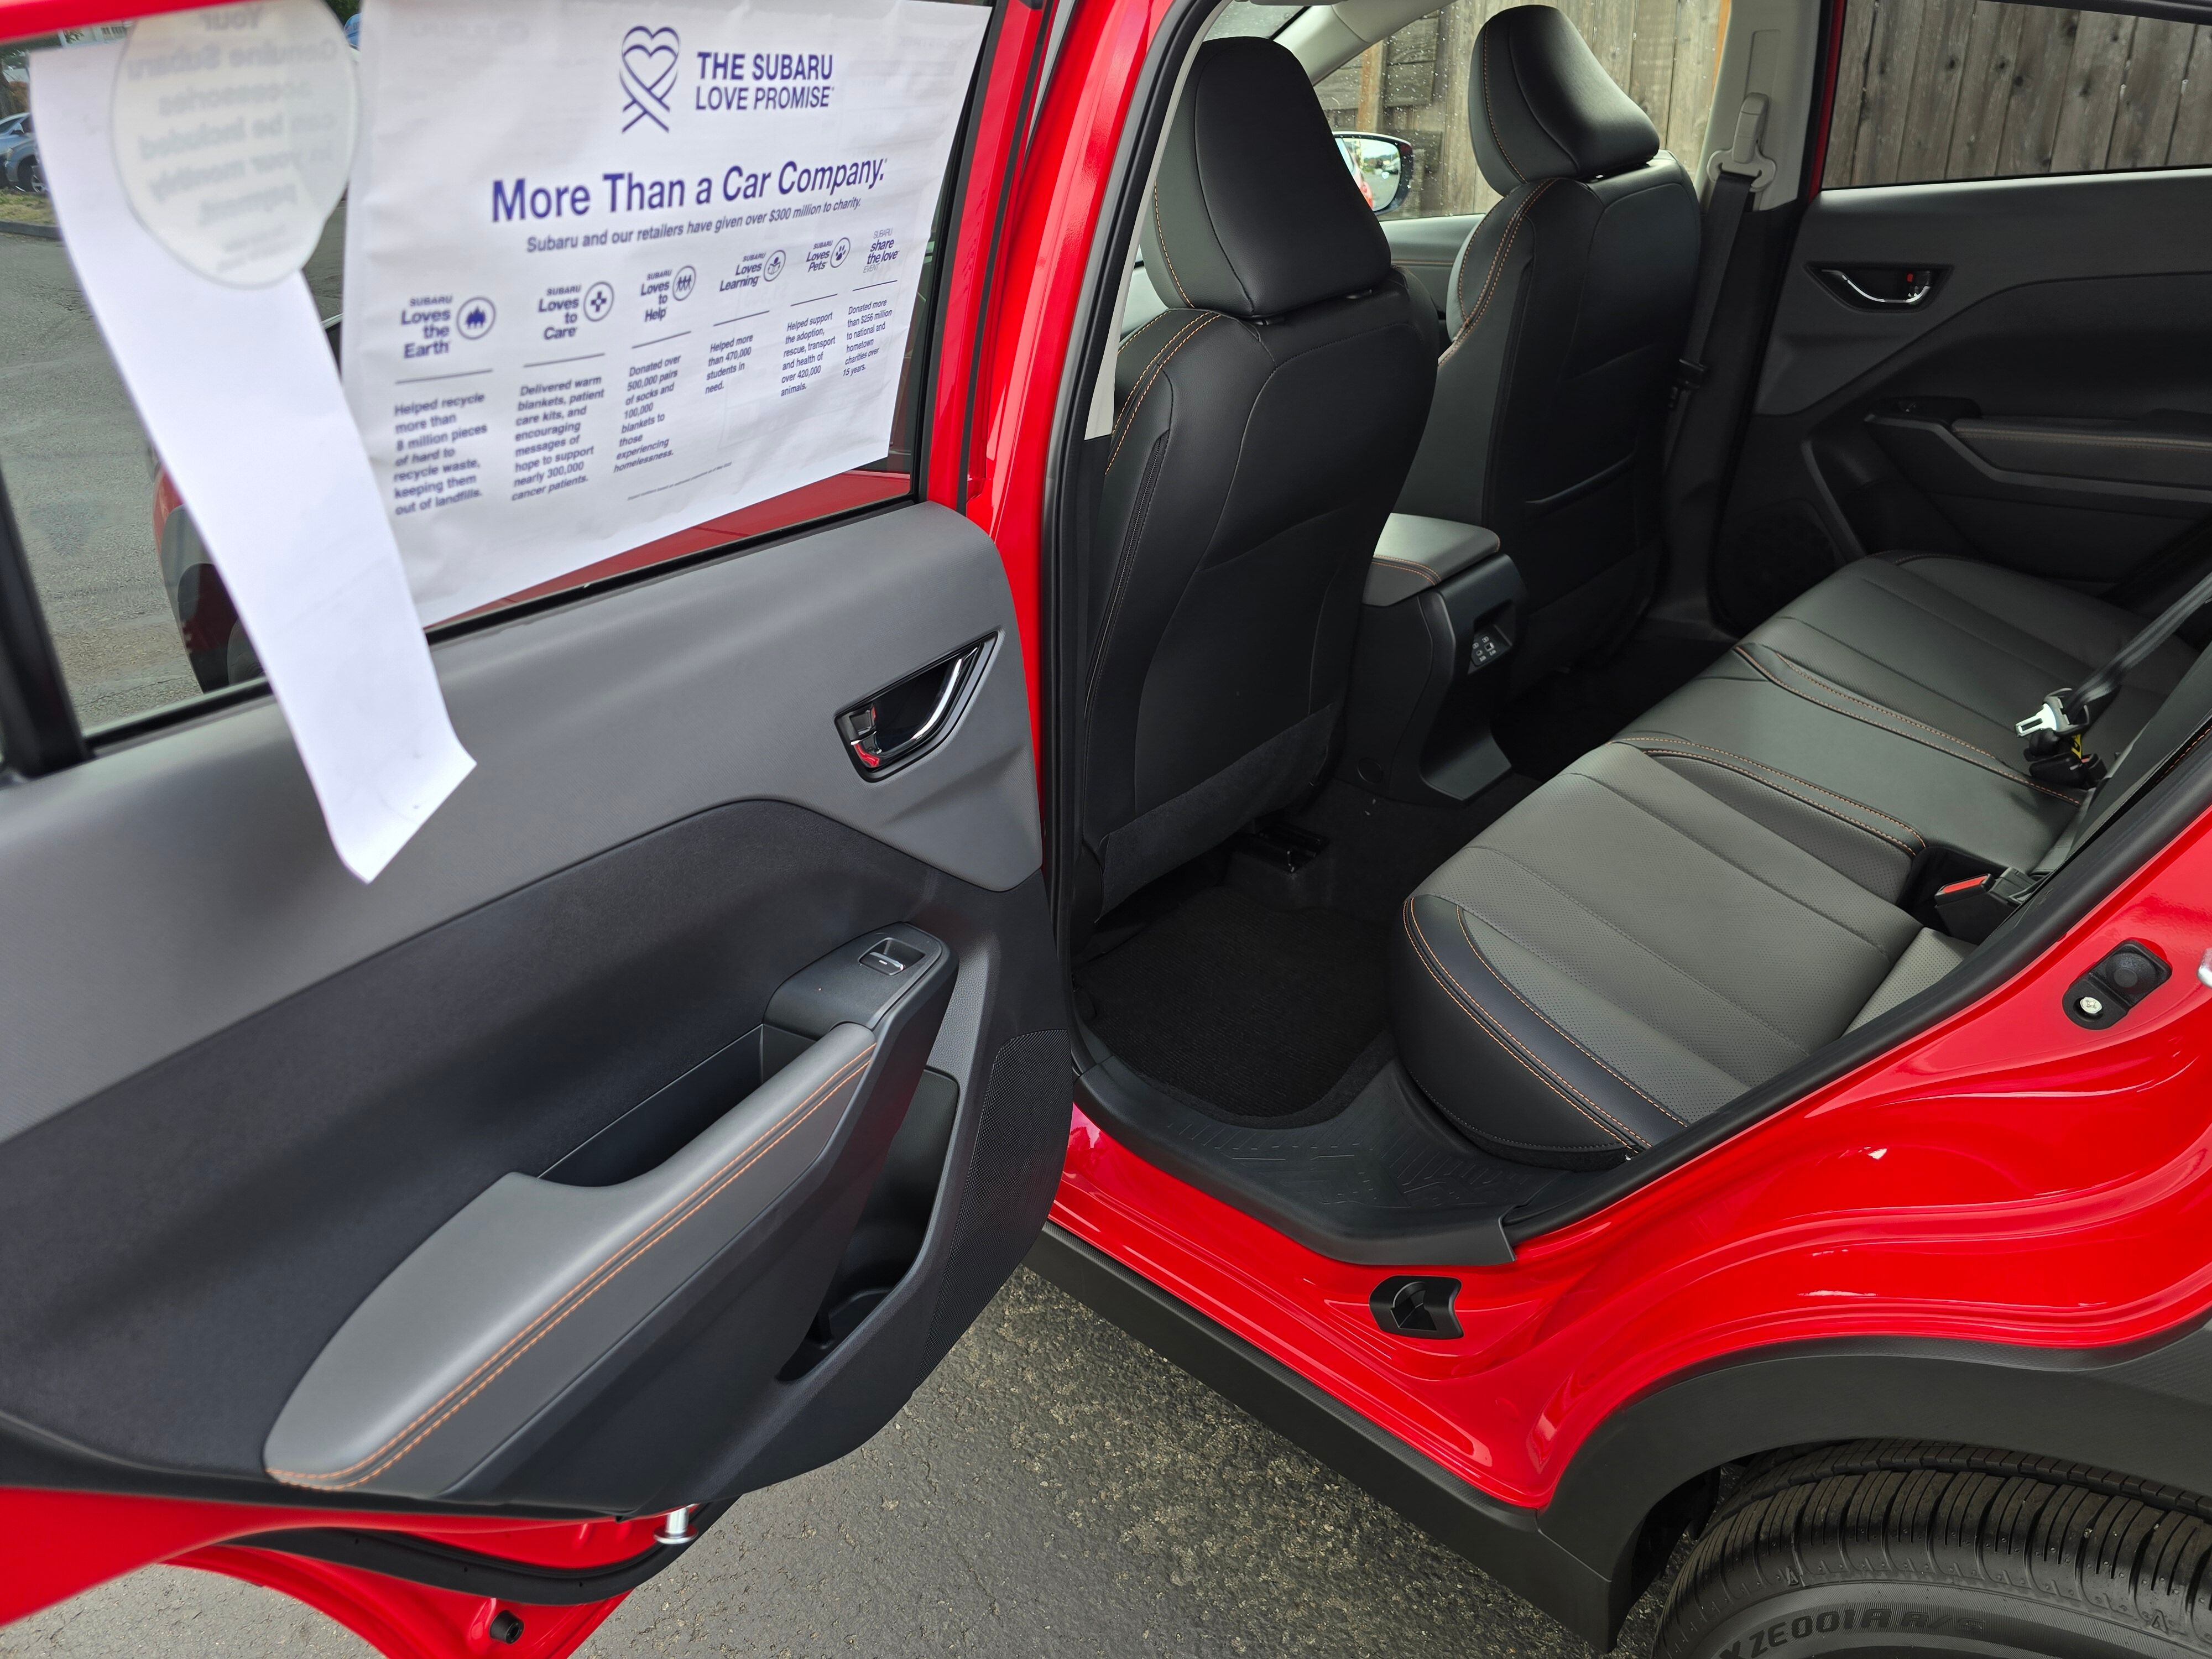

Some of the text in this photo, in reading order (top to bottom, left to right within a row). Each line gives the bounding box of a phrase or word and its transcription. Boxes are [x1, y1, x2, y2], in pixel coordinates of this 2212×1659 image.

[696, 52, 833, 80] THE SUBARU
[696, 85, 830, 111] LOVE PROMISE
[492, 157, 884, 223] More Than a Car Company.
[526, 196, 861, 253] Subaru and our retailers have given over $300 million to charity.
[873, 227, 893, 239] SUBARU
[813, 240, 833, 250] SUBARU
[870, 239, 894, 252] share
[742, 253, 766, 262] SUBARU
[805, 251, 830, 262] Loves
[647, 270, 672, 281] SUBARU
[735, 263, 762, 275] Loves
[807, 262, 826, 272] Pets
[863, 263, 880, 273] EVENT
[546, 285, 582, 296] SUBARU
[640, 281, 670, 296] Loves
[719, 275, 759, 292] Learning
[409, 295, 453, 307] SUBARU
[538, 298, 580, 312] Loves
[659, 294, 668, 305] to
[848, 299, 887, 315] Donated more
[401, 309, 451, 325] Loves
[565, 312, 578, 324] to
[645, 307, 666, 322] Help
[786, 311, 833, 332] Helped support
[847, 309, 892, 328] than $256 million
[423, 325, 450, 338] the
[544, 326, 576, 340] Care
[785, 327, 825, 345] the adoption,
[853, 325, 874, 338] national
[876, 321, 885, 331] and
[404, 341, 449, 358] Earth
[710, 335, 753, 353] Helped more
[783, 336, 836, 358] rescue, transport
[846, 338, 874, 353] hometown
[708, 347, 752, 367] than 470,000
[782, 351, 823, 371] and health of
[845, 347, 879, 366] charities over
[629, 355, 681, 377] Donated over
[707, 362, 745, 380] students in
[781, 365, 821, 384] over 420,000
[843, 365, 866, 377] 15 years.
[520, 376, 602, 397] Delivered warm
[627, 369, 678, 392] 500,000 pairs
[706, 380, 724, 394] need.
[781, 382, 806, 397] animals.
[518, 389, 605, 411] blankets, patient
[625, 383, 675, 406] of socks and
[394, 393, 486, 416] Helped recycle
[624, 402, 654, 420] 100,000
[395, 413, 457, 434] more than
[516, 406, 587, 426] care kits, and
[515, 422, 581, 442] encouraging
[621, 418, 655, 434] blankets
[397, 424, 488, 451] 8 million pieces
[515, 435, 580, 457] messages of
[619, 434, 643, 447] those
[395, 447, 455, 467] of hard to
[616, 438, 669, 460] experiencing
[515, 446, 594, 473] hope to support
[613, 450, 674, 473] homelessness.
[393, 459, 481, 482] recycle waste,
[514, 461, 584, 487] nearly 300,000
[394, 474, 477, 499] keeping them
[512, 476, 589, 501] cancer patients.
[395, 488, 483, 515] out of landfills.
